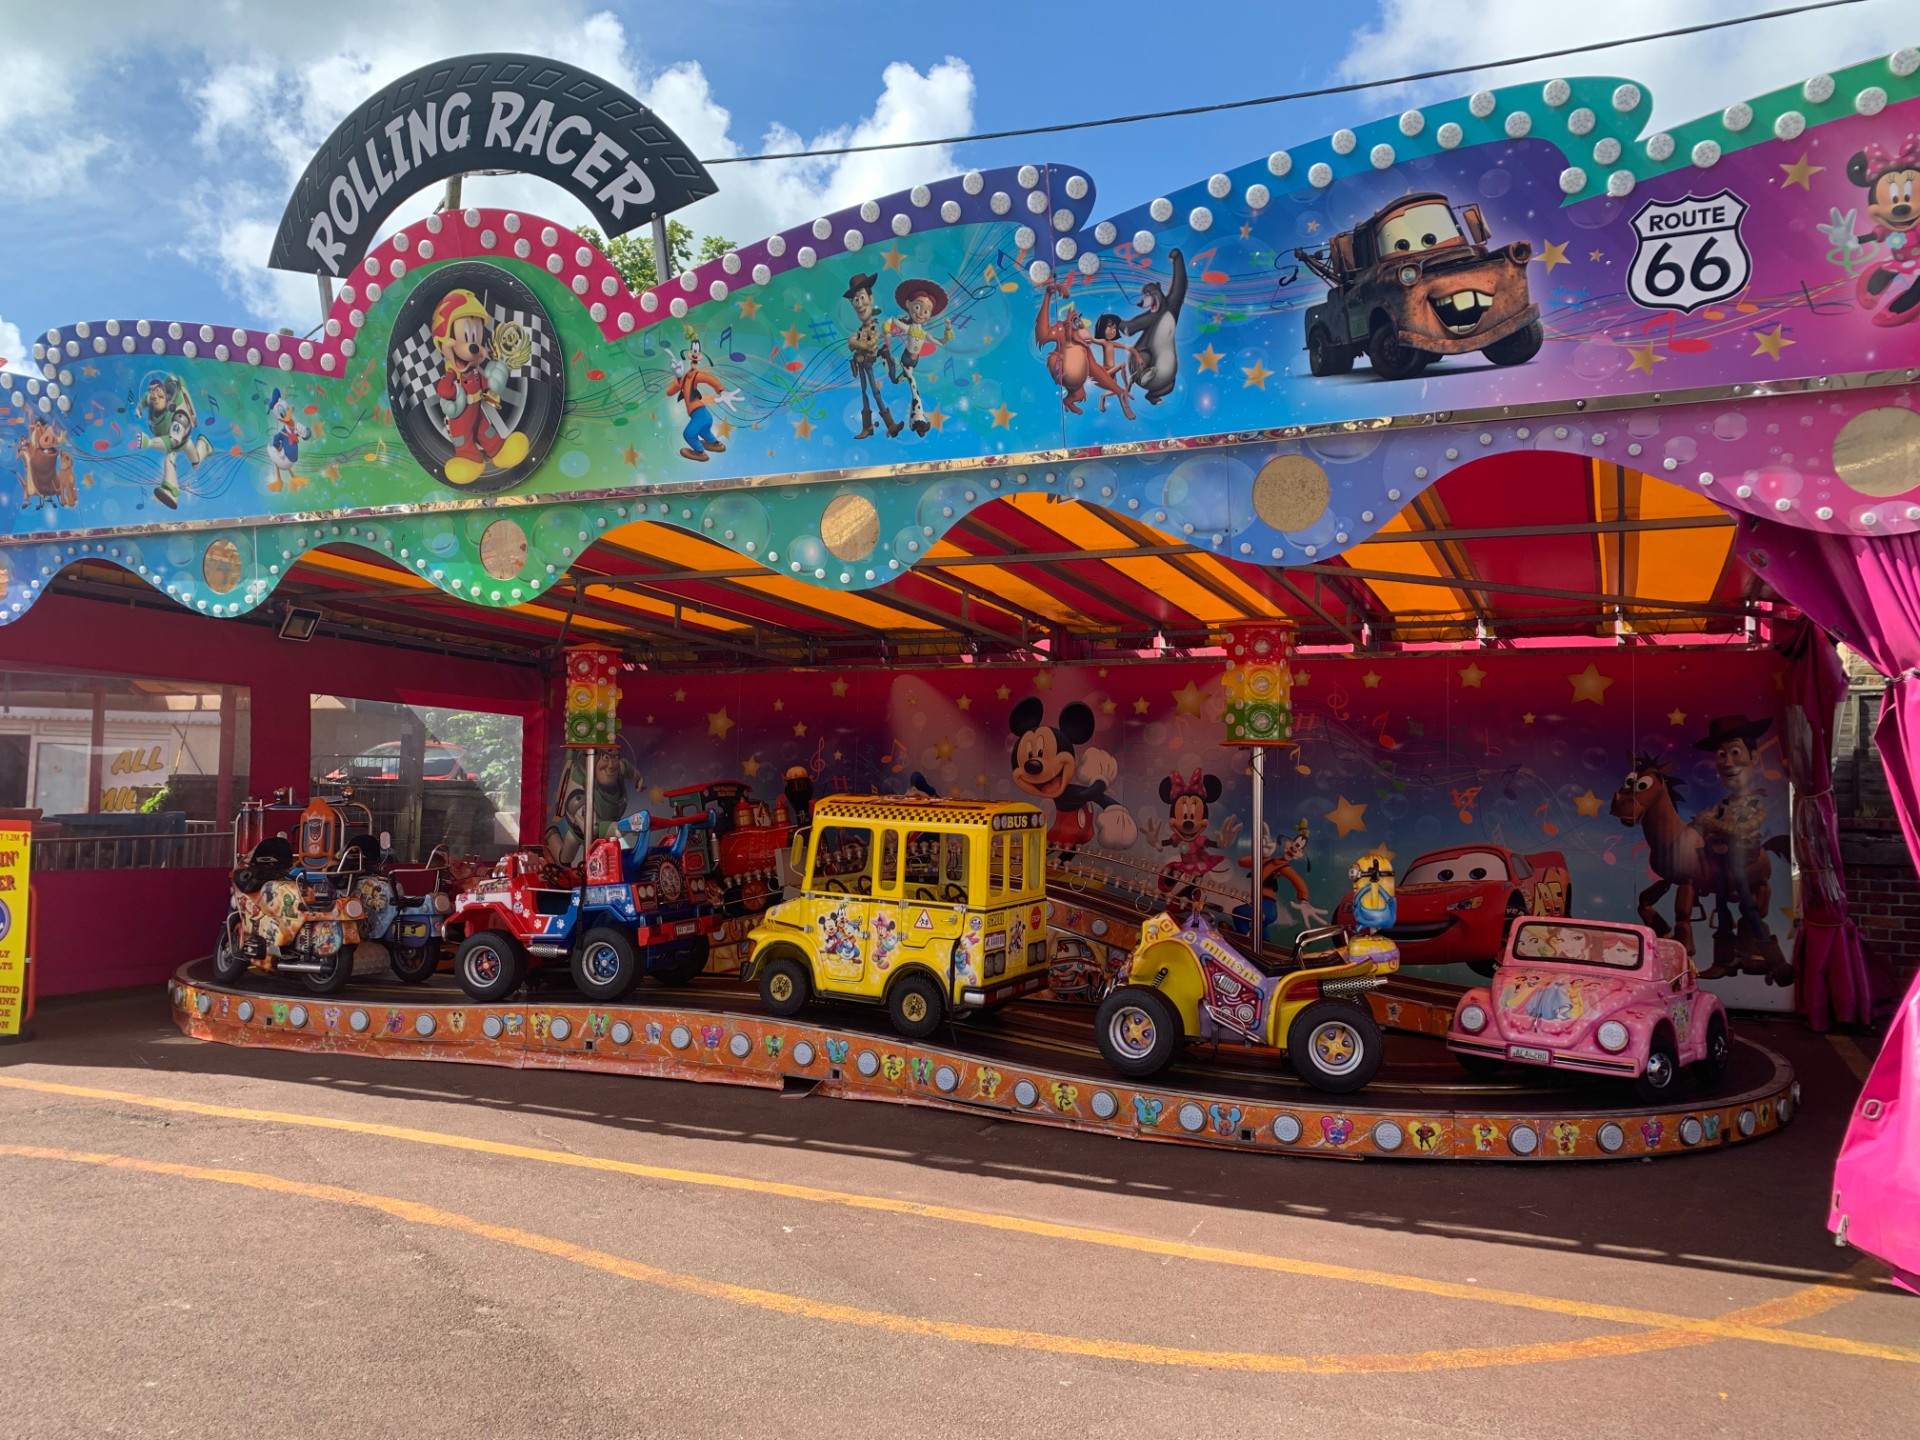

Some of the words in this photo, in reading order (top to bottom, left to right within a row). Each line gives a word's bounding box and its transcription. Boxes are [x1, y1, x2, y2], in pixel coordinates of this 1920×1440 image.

[307, 91, 472, 276] ROLLING
[484, 91, 655, 220] RACER
[1650, 206, 1725, 232] ROUTE
[1645, 236, 1731, 297] 66
[111, 746, 163, 775] ALL
[1007, 815, 1028, 828] BUS
